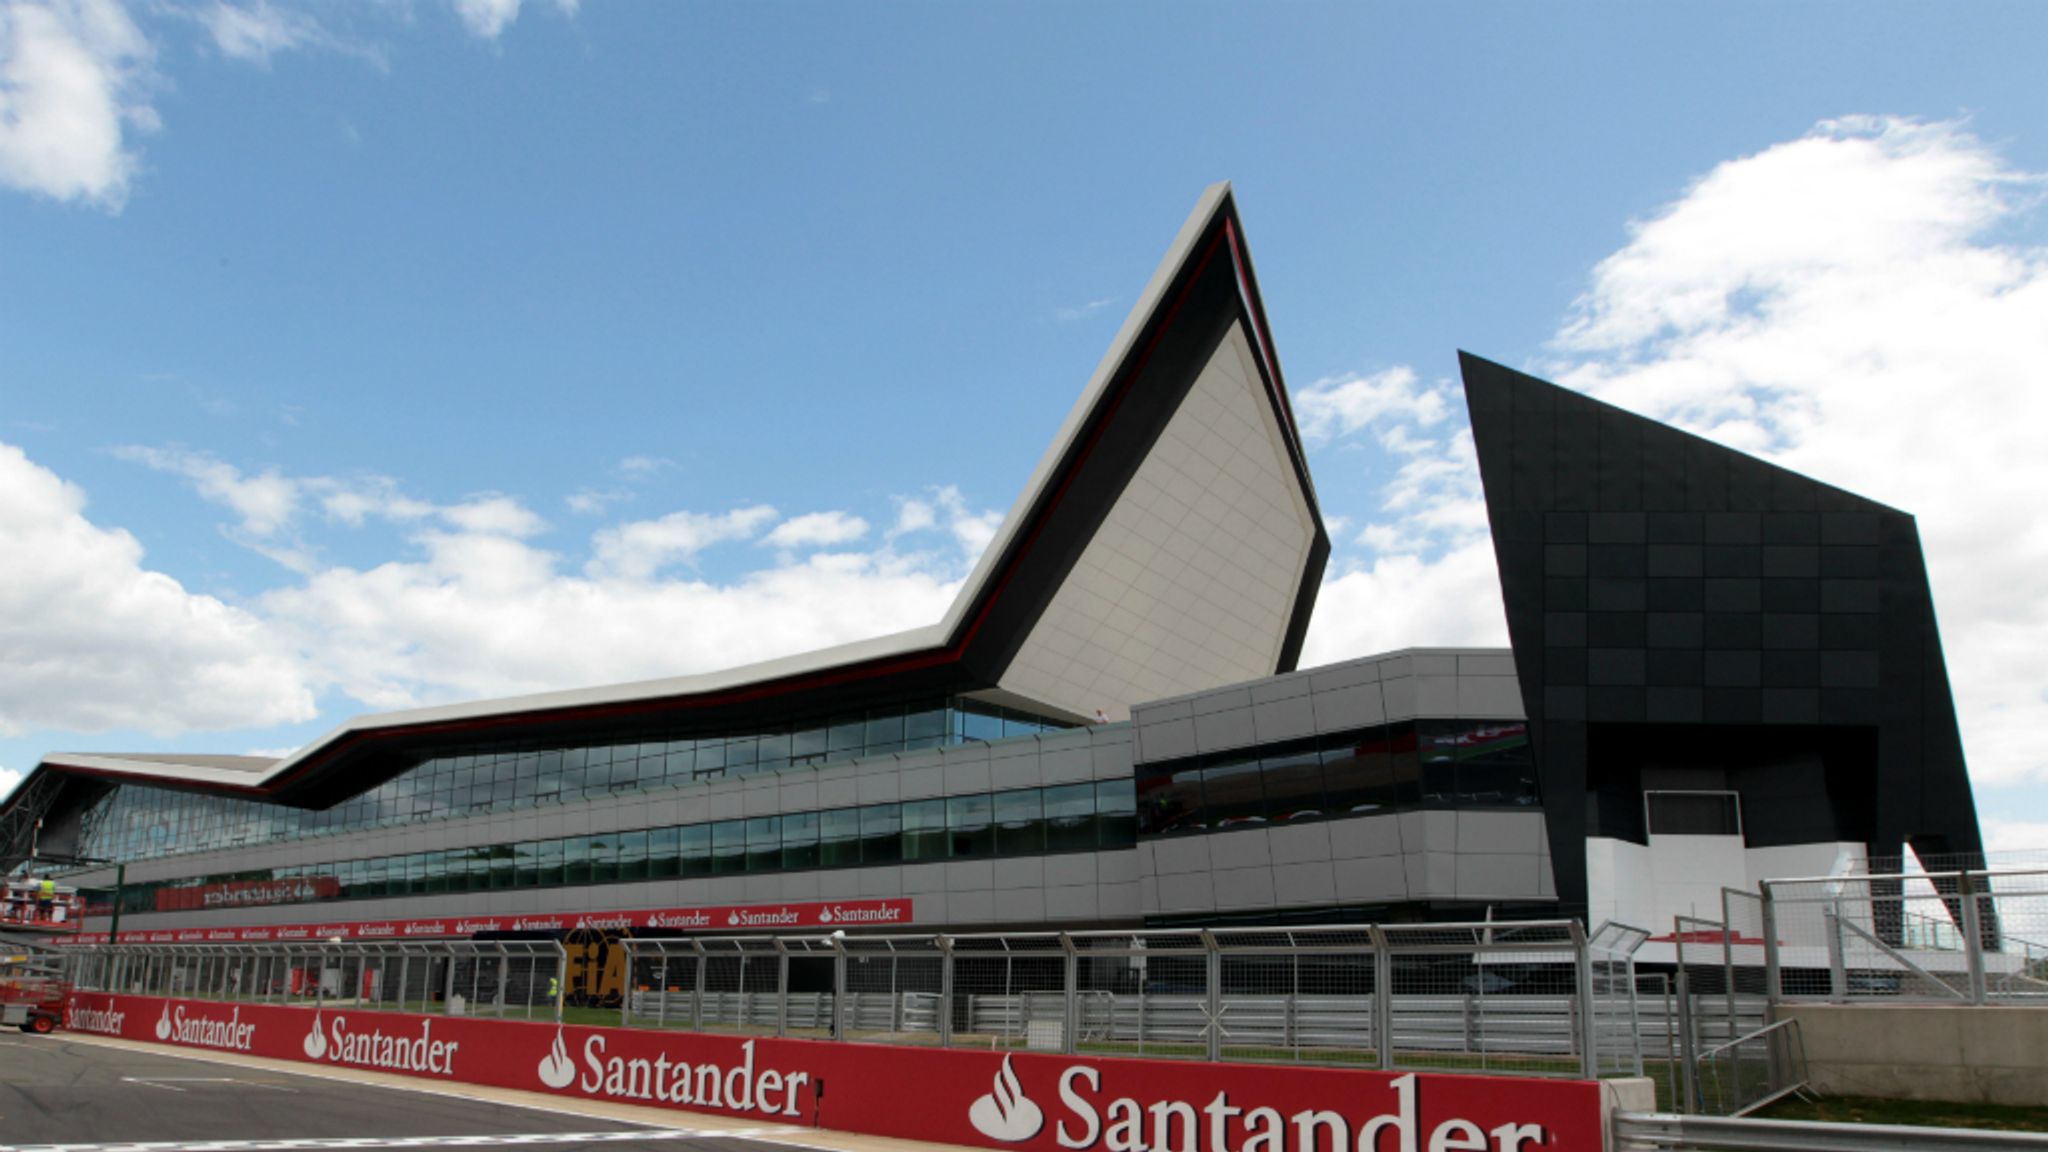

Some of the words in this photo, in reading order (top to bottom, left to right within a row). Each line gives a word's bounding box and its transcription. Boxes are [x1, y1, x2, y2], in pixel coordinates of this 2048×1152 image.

[657, 911, 711, 927] Santander
[740, 908, 799, 925] Santander
[834, 903, 901, 921] Santander
[172, 1005, 255, 1050] Santander
[329, 1016, 459, 1075] Santander
[581, 1034, 808, 1116] Santander
